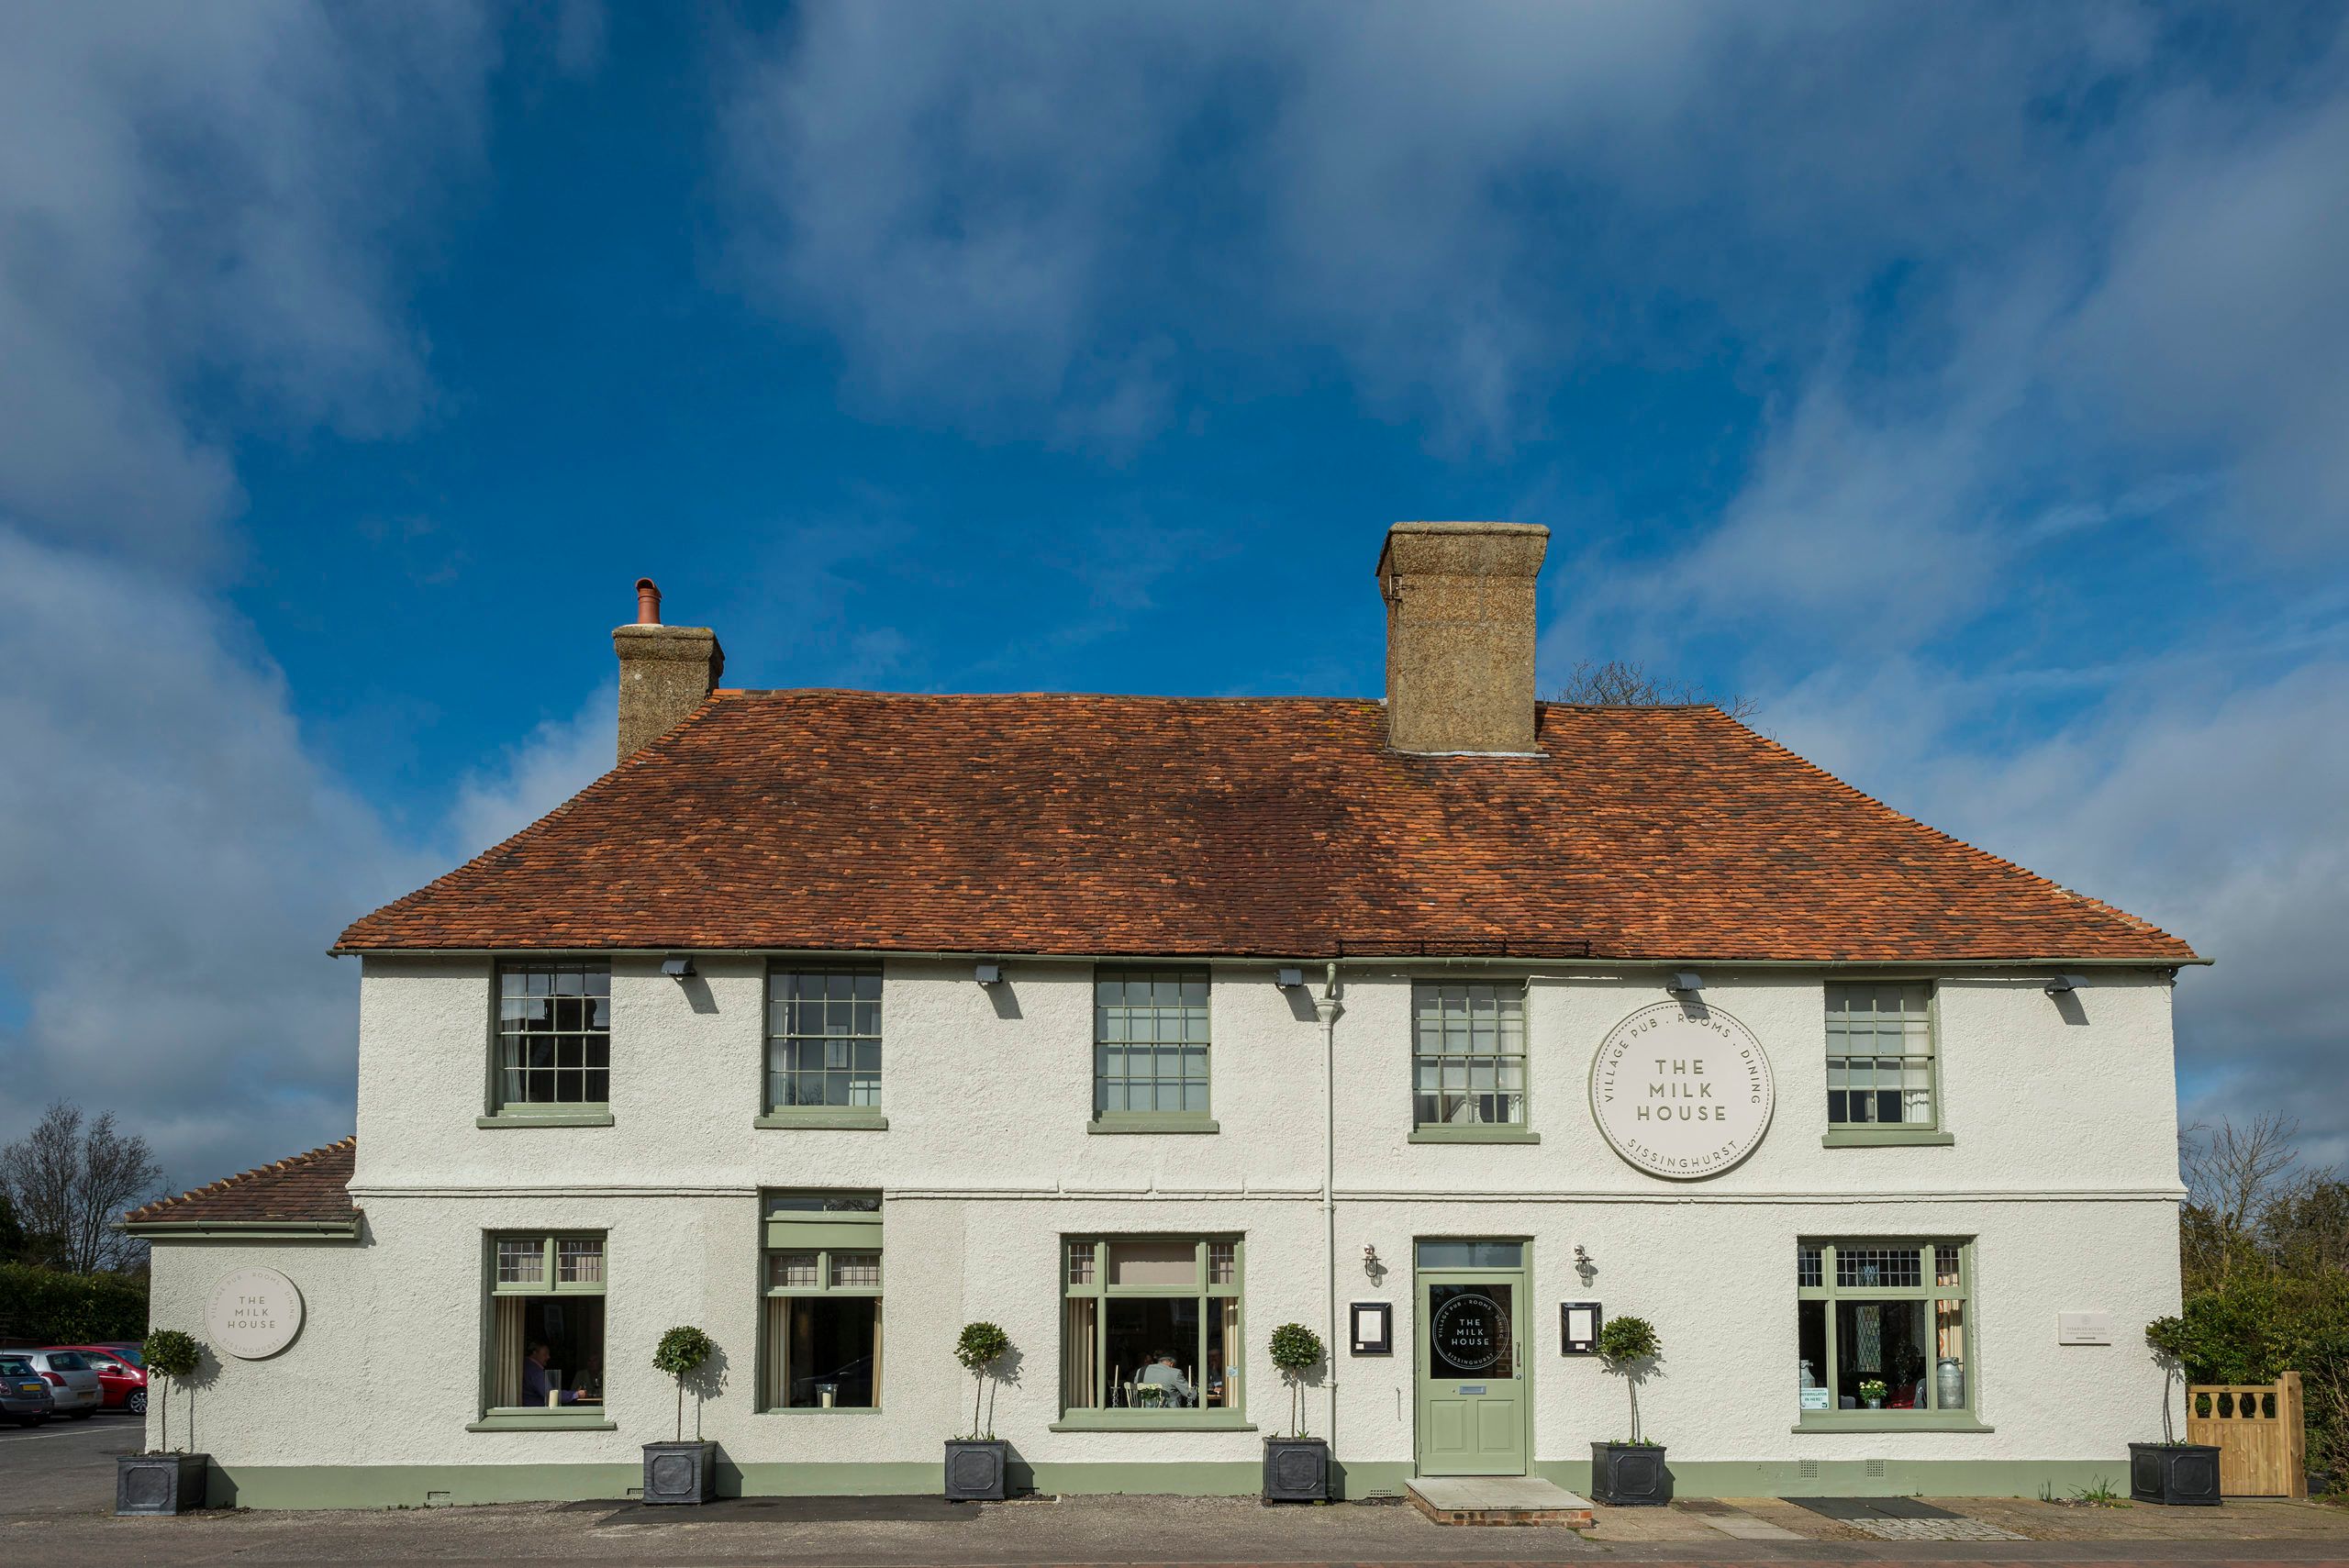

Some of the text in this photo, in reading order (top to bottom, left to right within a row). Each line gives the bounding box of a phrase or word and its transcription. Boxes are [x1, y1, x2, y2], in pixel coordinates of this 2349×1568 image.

[1605, 1013, 1761, 1104] VILLAGE PUB ROOMS DINING
[1655, 1059, 1704, 1074] THE
[1649, 1083, 1712, 1098] MILK
[1637, 1105, 1726, 1121] HOUSE
[1627, 1139, 1738, 1168] SISSINGHURST
[211, 1272, 295, 1320] VILLAGE PUB ROOMS DINING
[239, 1296, 266, 1305] THE
[235, 1308, 269, 1317] MILK
[1438, 1300, 1504, 1339] VILLAGE PUB ROOMS DINING
[223, 1337, 282, 1354] SISSINGHURST
[1447, 1352, 1494, 1365] SISSINGHURST
